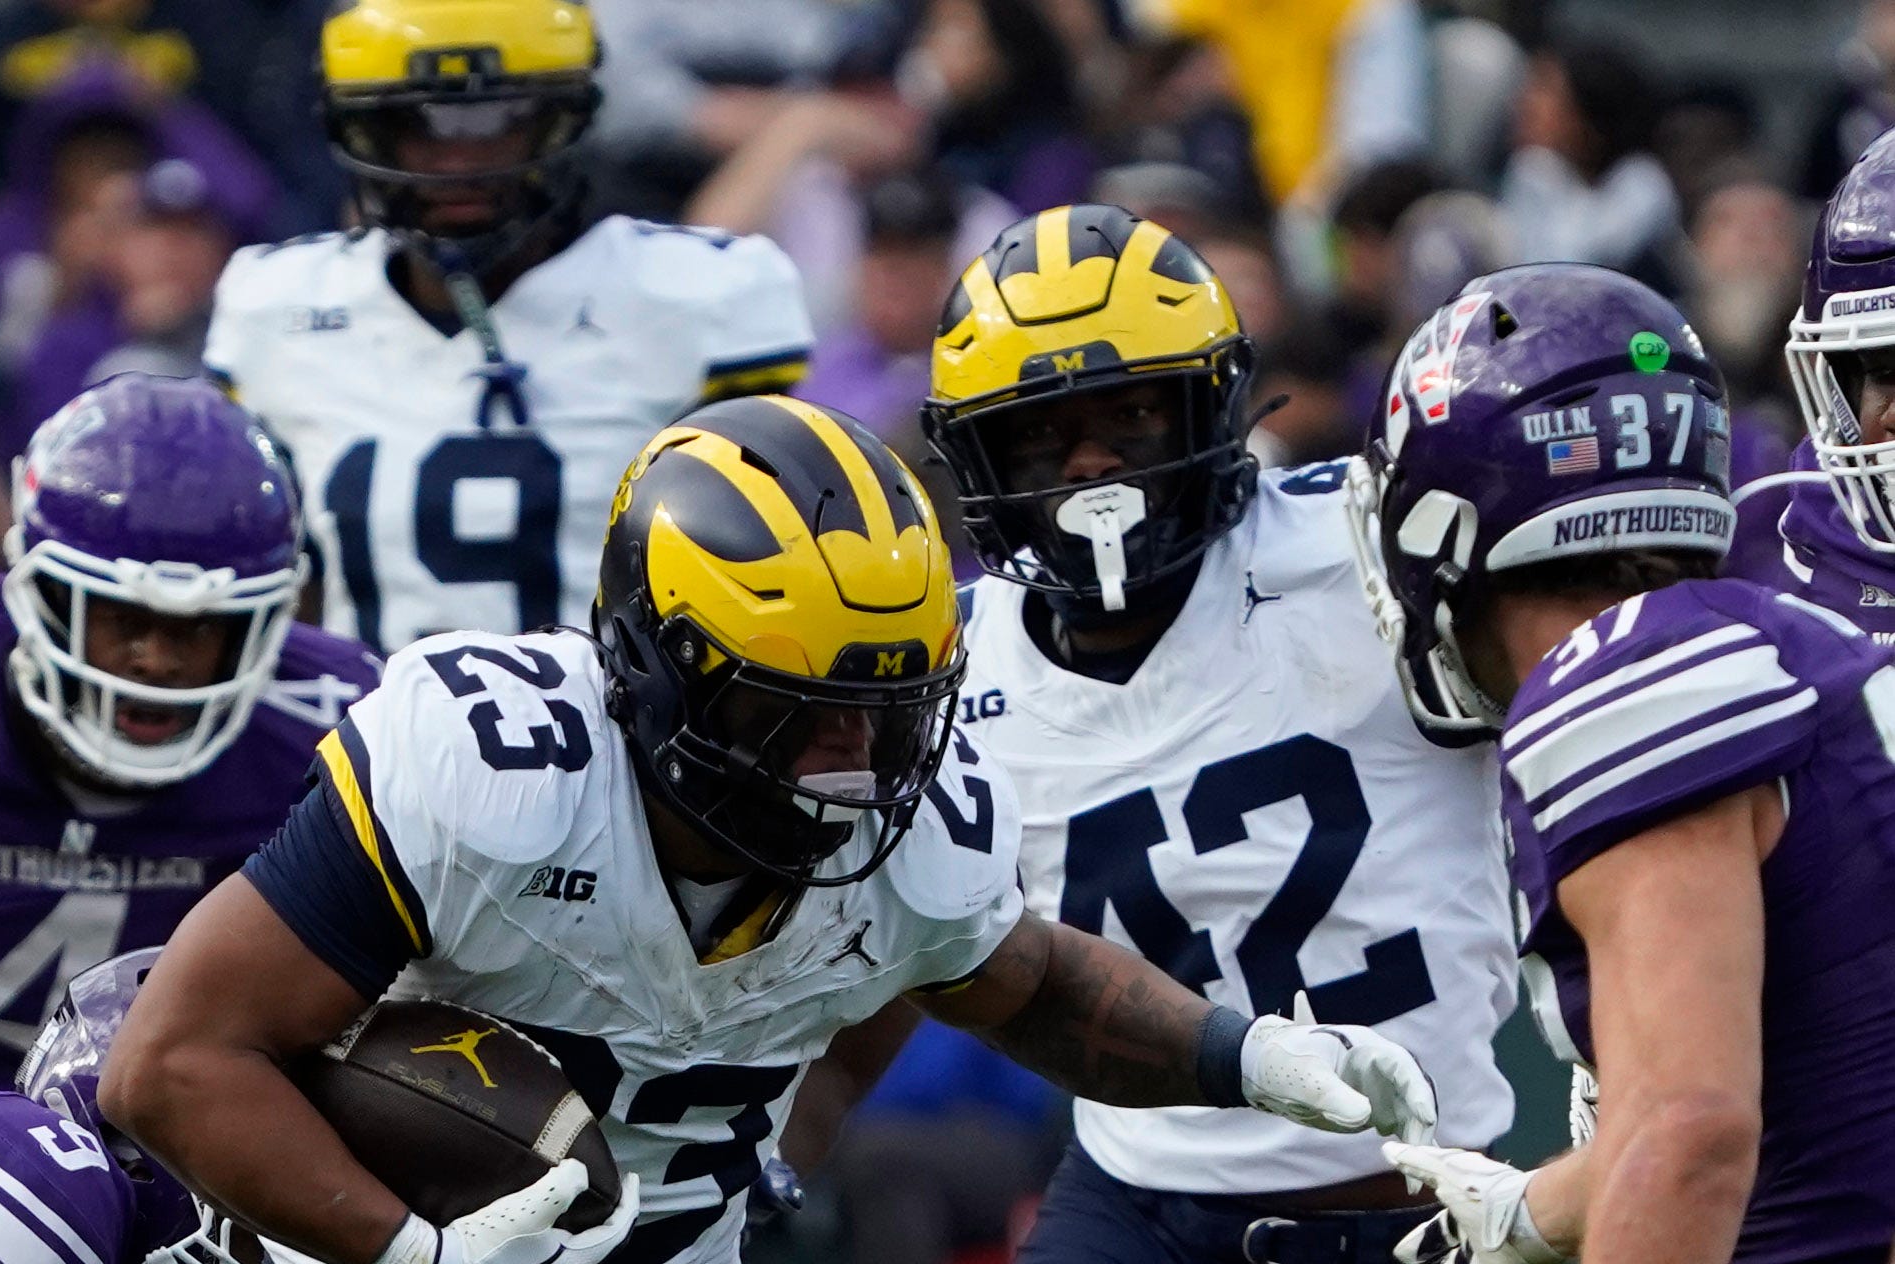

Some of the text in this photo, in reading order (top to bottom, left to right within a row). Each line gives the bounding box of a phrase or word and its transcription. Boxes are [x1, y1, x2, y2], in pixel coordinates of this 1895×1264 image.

[1831, 291, 1895, 318] WILDCATS
[1521, 405, 1598, 445] W.I.N.
[1610, 393, 1695, 470] 37
[323, 435, 562, 652] 19
[1552, 505, 1733, 548] NORTHWESTERN
[874, 650, 906, 678] M
[423, 643, 594, 774] 23
[1058, 731, 1437, 1027] 42
[28, 1119, 110, 1173] 9
